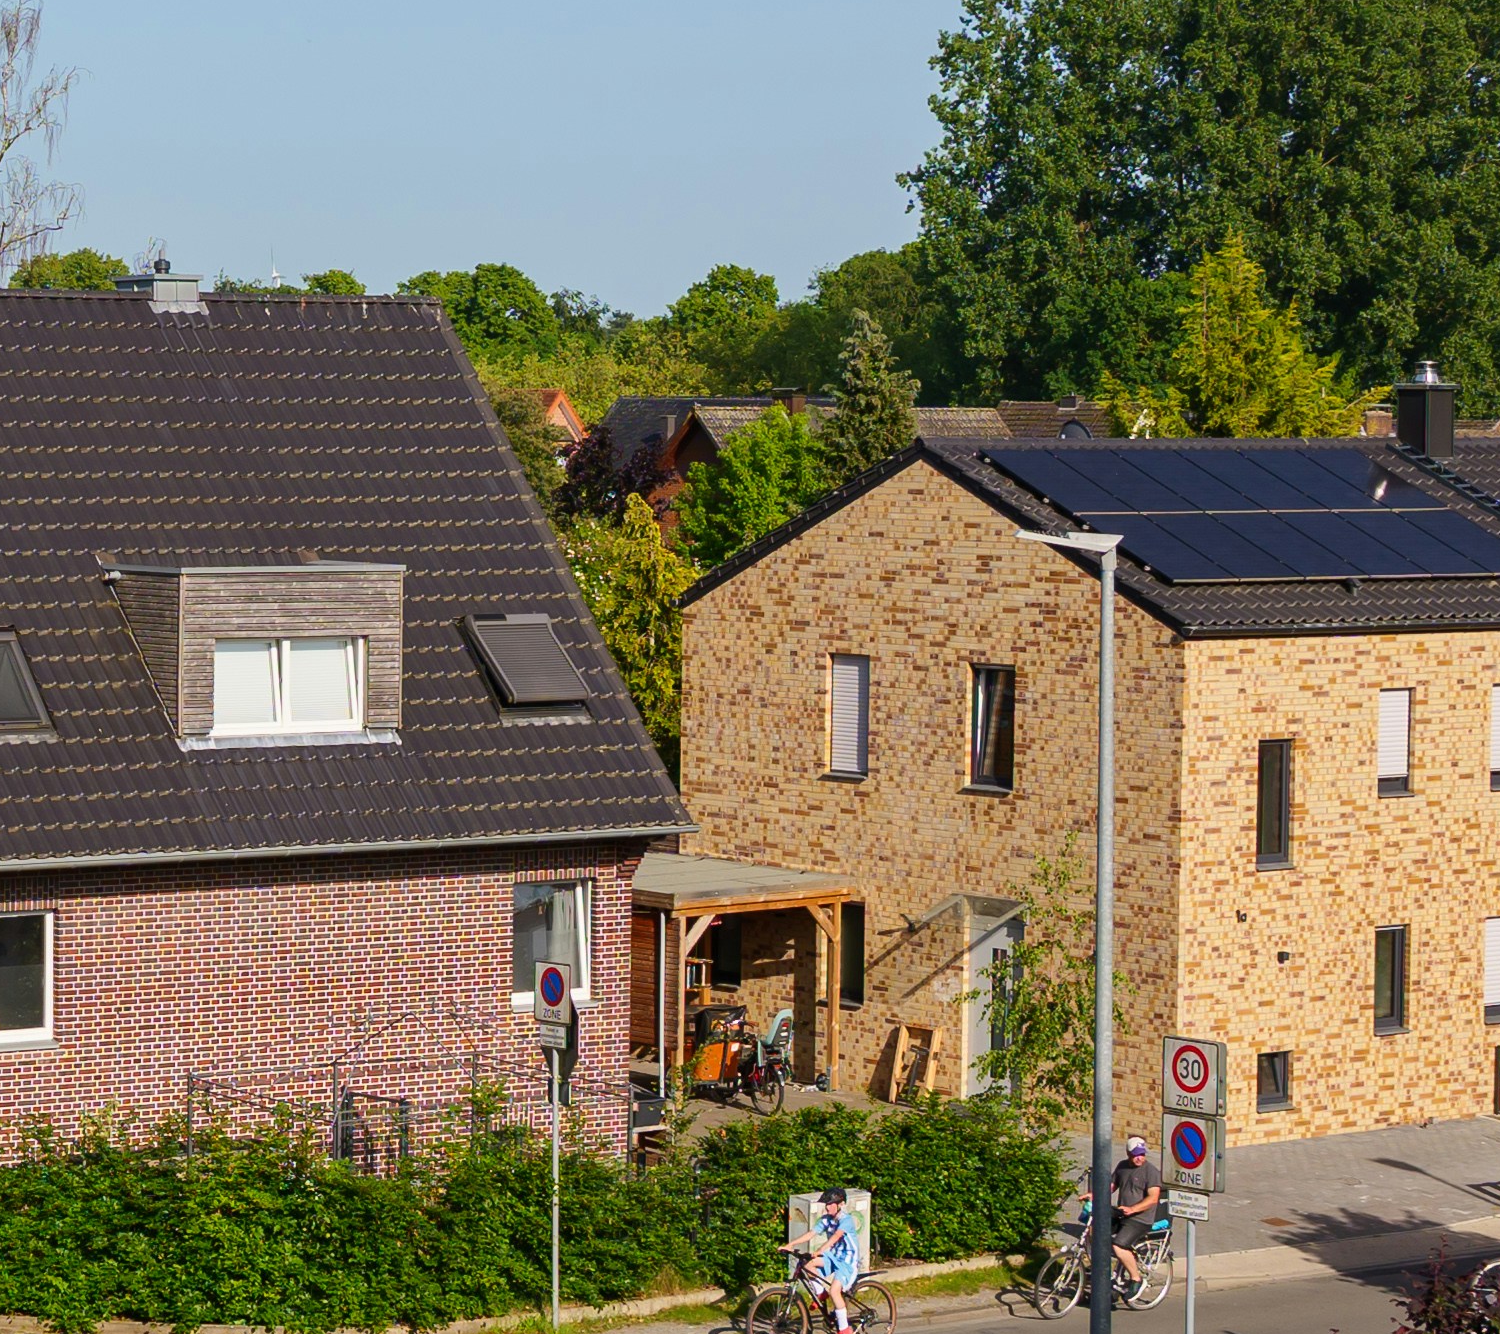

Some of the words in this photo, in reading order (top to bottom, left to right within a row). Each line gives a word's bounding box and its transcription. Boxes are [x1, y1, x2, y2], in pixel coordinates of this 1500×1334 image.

[542, 1007, 562, 1020] ZONE
[1179, 1057, 1201, 1081] 30
[1176, 1094, 1204, 1110] ZONE
[1174, 1169, 1202, 1186] ZONE
